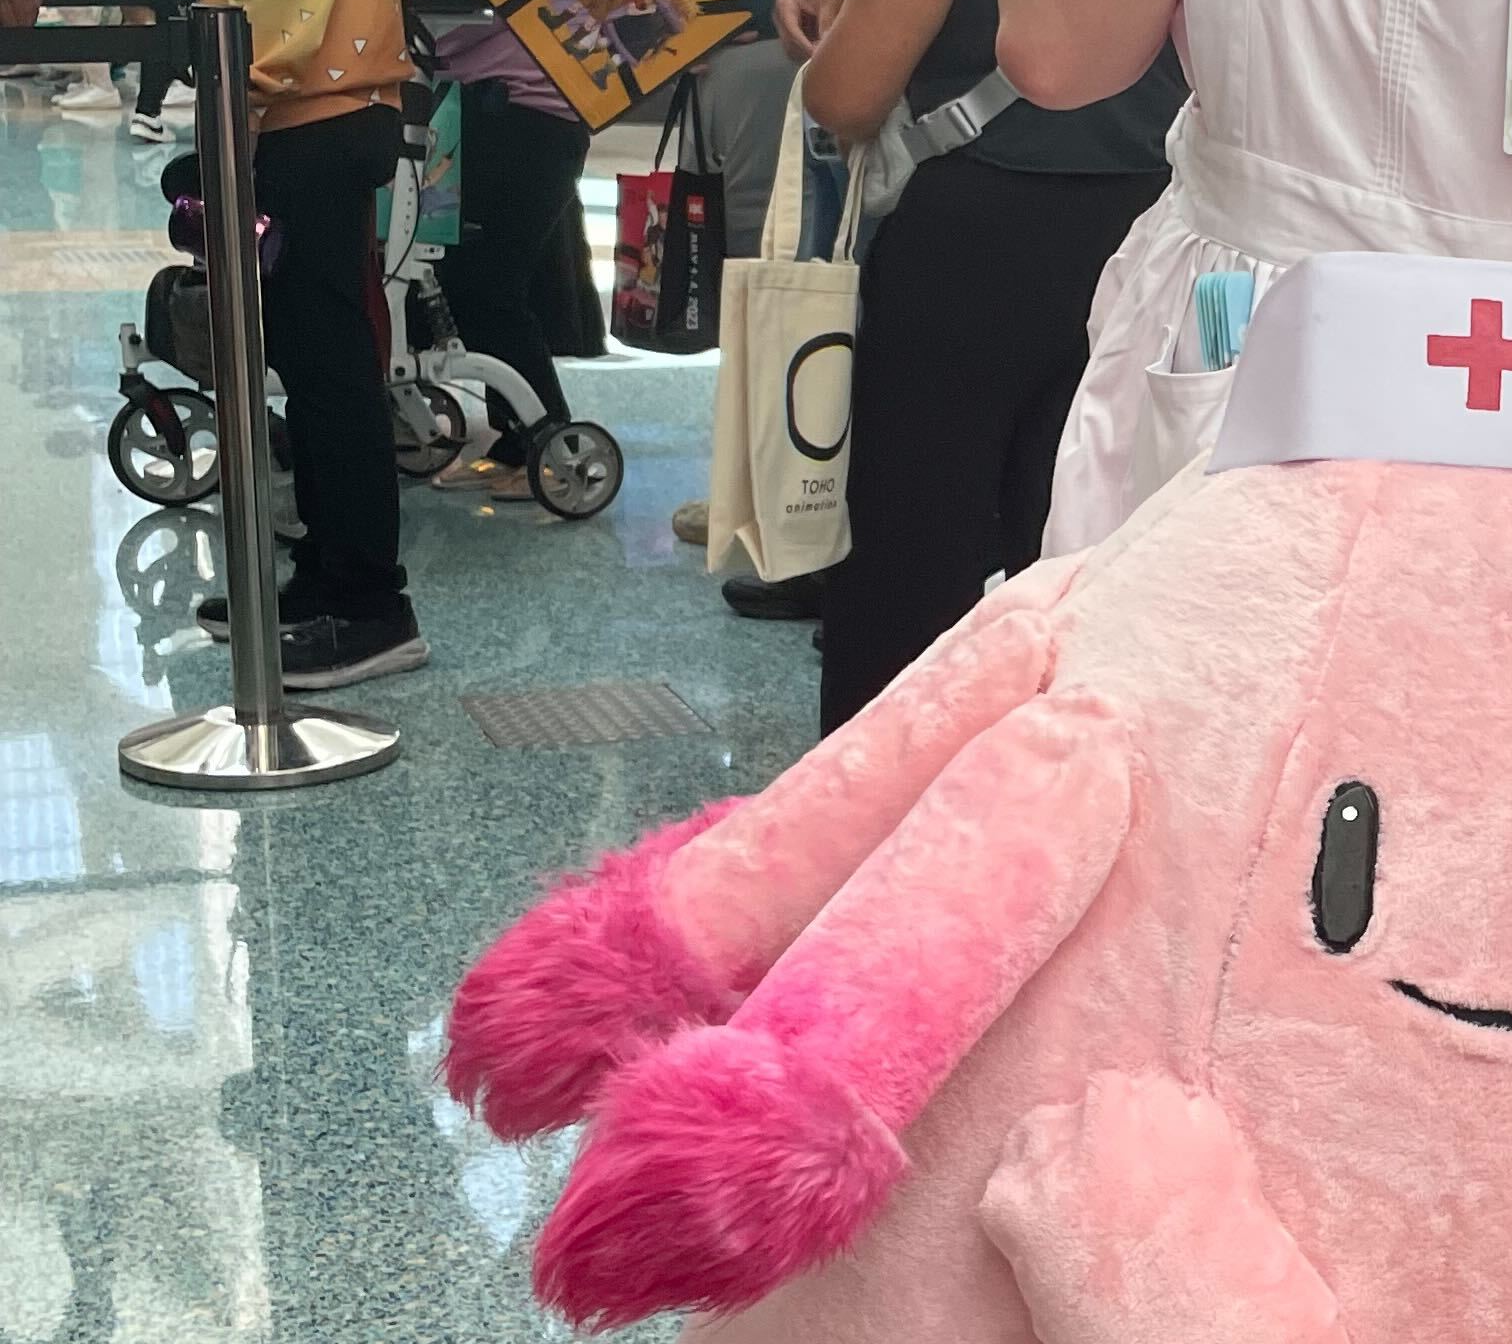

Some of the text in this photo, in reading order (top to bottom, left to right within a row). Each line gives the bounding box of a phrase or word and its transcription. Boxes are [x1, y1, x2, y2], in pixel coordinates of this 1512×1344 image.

[686, 296, 699, 330] 2023
[802, 477, 835, 496] TOHO
[786, 498, 838, 515] animation
